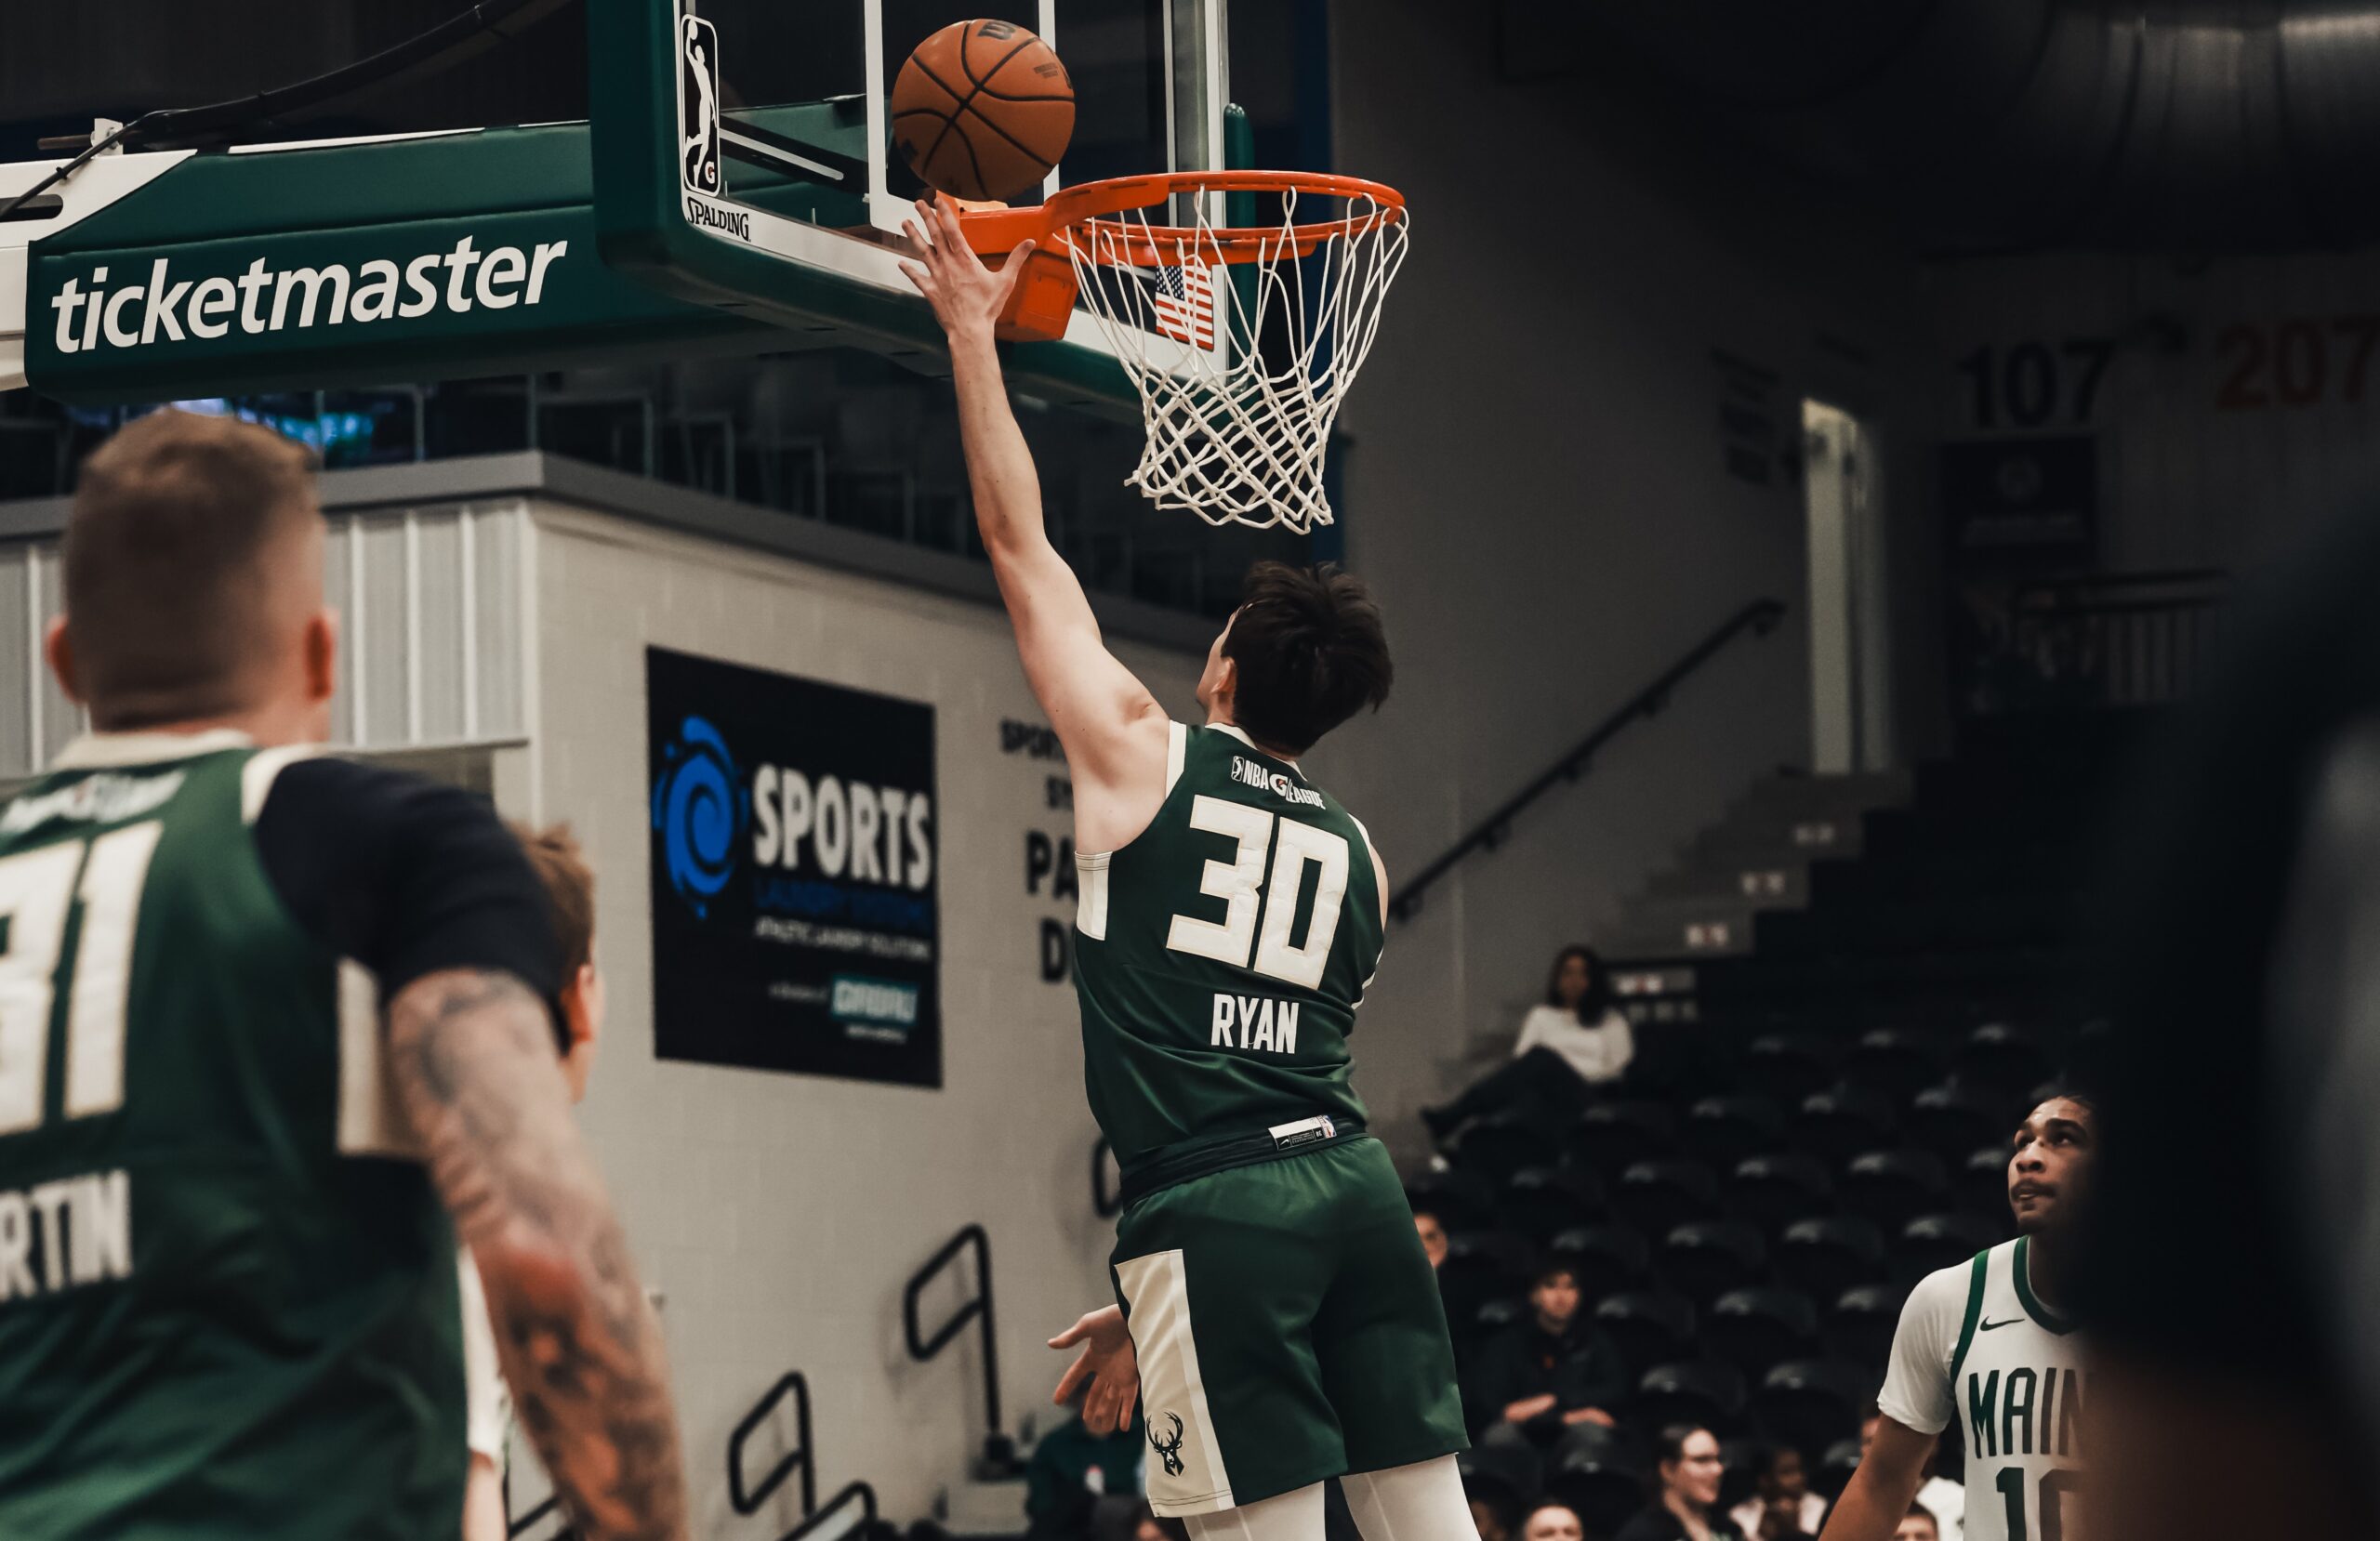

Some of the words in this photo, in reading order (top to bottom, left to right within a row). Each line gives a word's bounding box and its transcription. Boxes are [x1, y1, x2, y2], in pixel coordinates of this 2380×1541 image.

[687, 196, 749, 243] SPALDING
[51, 235, 568, 354] ticketmaster
[1958, 340, 2116, 428] 107
[2216, 314, 2380, 409] 207
[1243, 759, 1270, 791] NBA
[752, 762, 931, 891] SPORTS
[1166, 794, 1349, 991] 30
[1211, 994, 1300, 1054] RYAN
